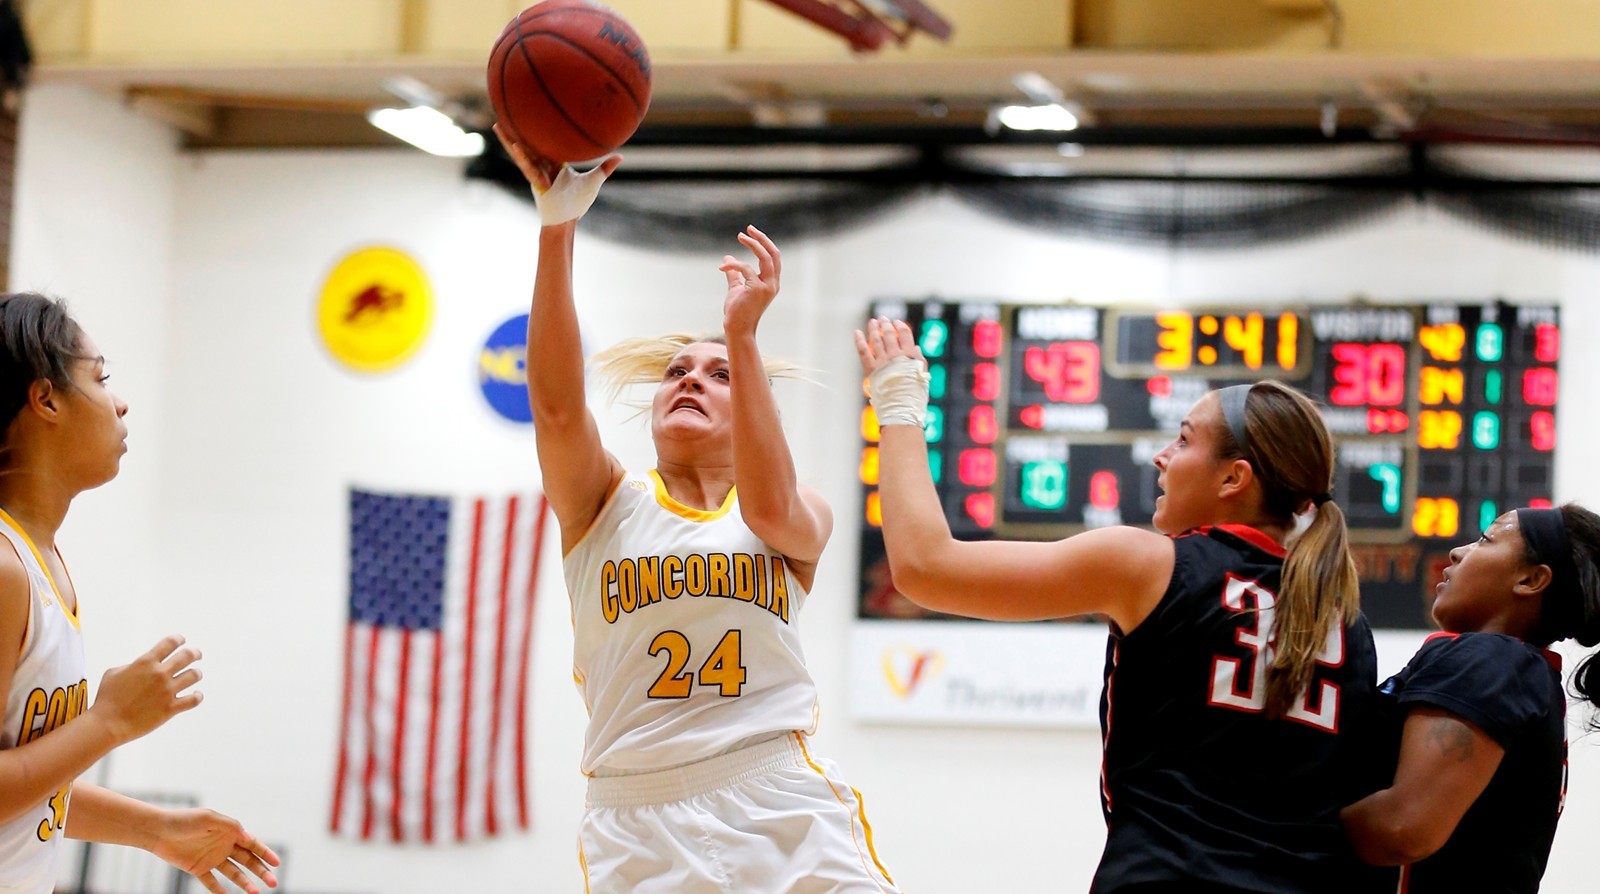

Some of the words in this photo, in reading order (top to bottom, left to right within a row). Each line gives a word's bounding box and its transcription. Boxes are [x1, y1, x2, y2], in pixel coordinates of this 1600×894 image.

[478, 346, 528, 385] NC
[1155, 310, 1298, 371] 3:41
[1024, 340, 1101, 404] 43
[1330, 343, 1406, 406] 30
[1418, 366, 1464, 405] 34
[1368, 463, 1402, 514] 7
[1412, 497, 1459, 537] 23
[601, 553, 789, 624] CONCORDIA
[648, 629, 746, 698] 24
